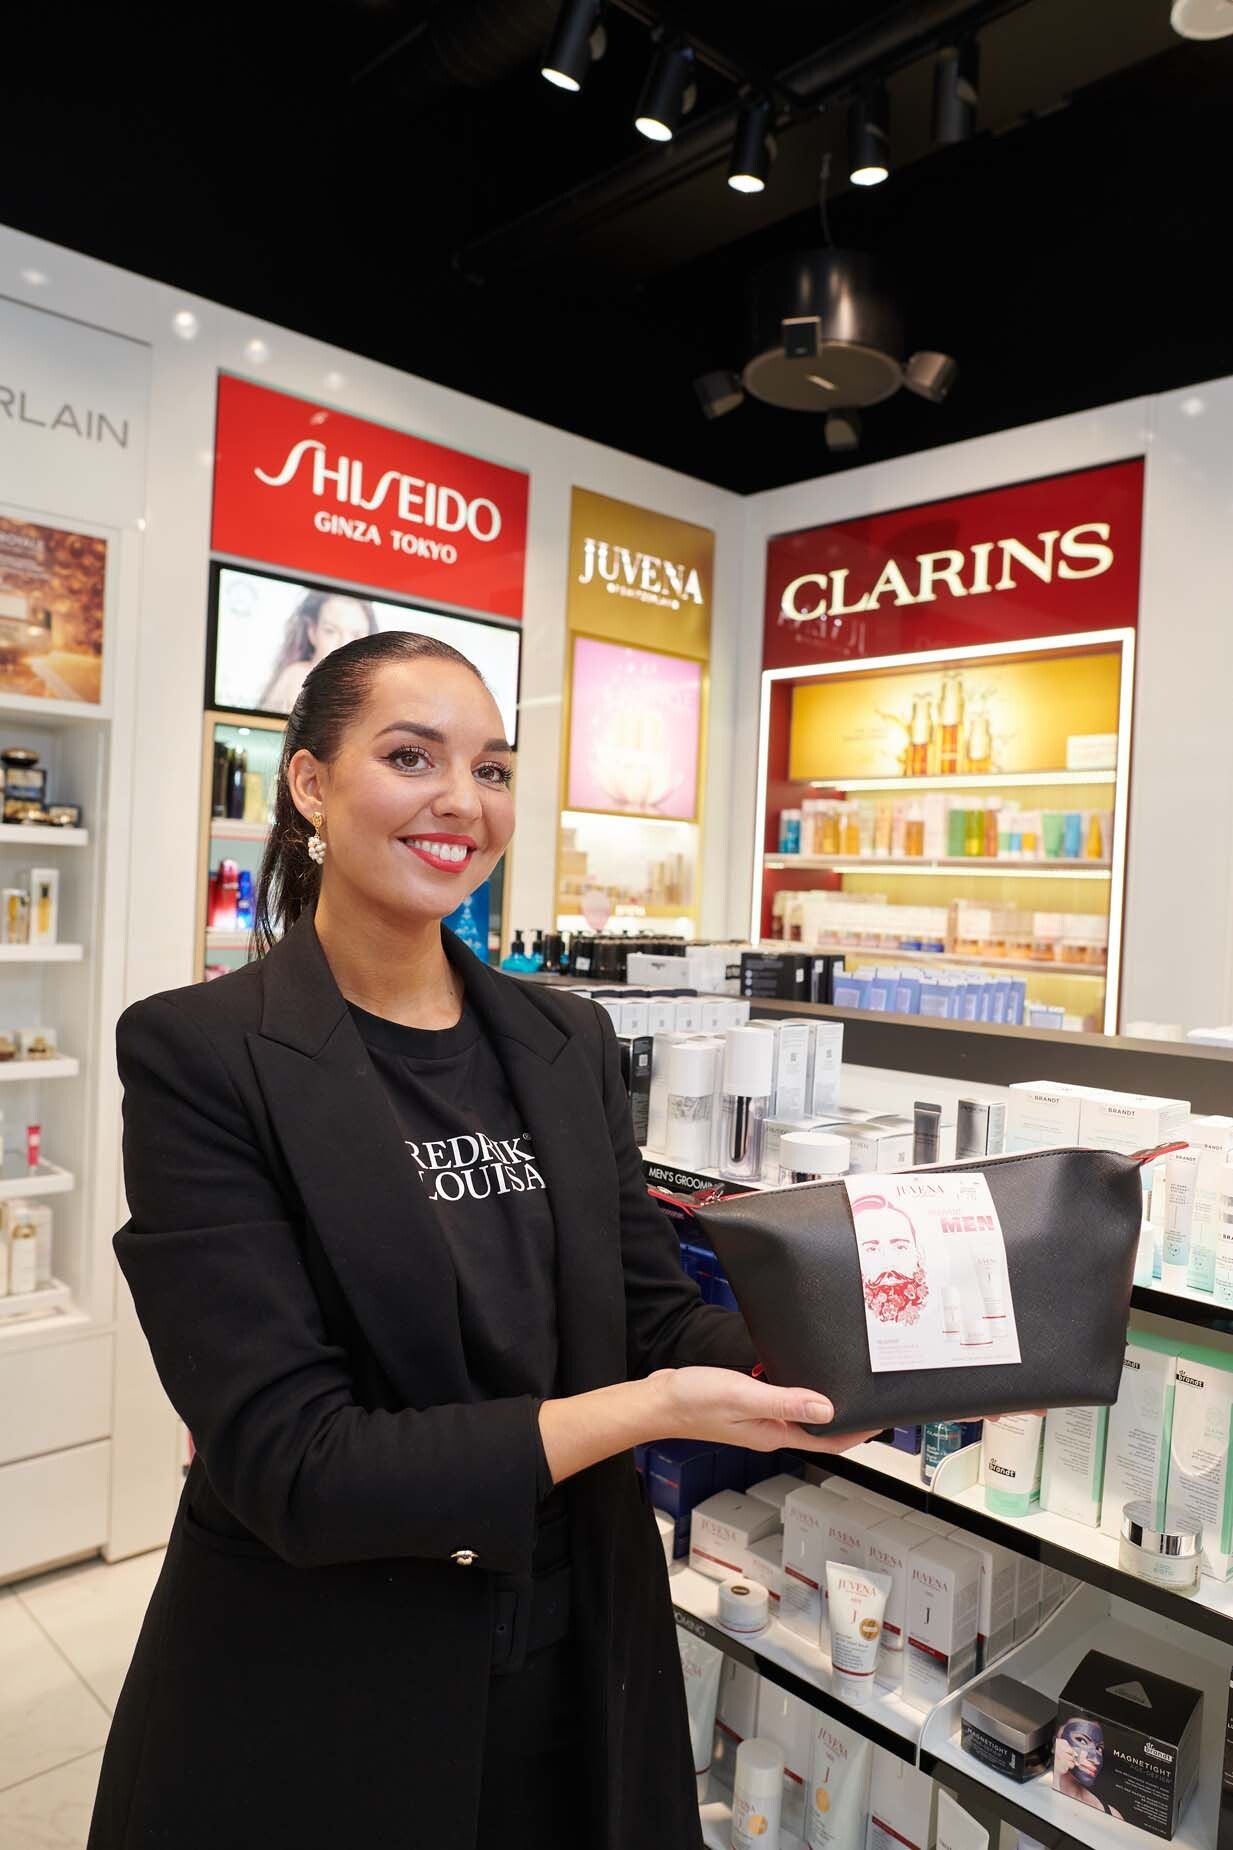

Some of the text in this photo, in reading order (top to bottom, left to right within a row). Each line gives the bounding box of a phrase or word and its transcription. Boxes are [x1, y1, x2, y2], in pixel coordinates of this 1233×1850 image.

[254, 439, 501, 541] SHISEIDO
[314, 511, 458, 564] GINZA TOKYO
[578, 537, 704, 605] JUVENA
[780, 522, 1114, 621] CLARINS
[1034, 1095, 1060, 1104] BRANDT
[1108, 1107, 1135, 1117] BRANDT
[648, 1167, 674, 1183] MEN'S
[941, 1215, 995, 1233] MEN
[1177, 1375, 1204, 1388] brandt
[989, 1463, 1016, 1478] brandt
[870, 1546, 903, 1569] JUVENA
[838, 1578, 877, 1598] JUVENA
[912, 1568, 949, 1593] JUVENA
[817, 1727, 849, 1761] JUVENA
[967, 1727, 1008, 1756] MAGNETIGHT
[1113, 1749, 1171, 1778] MAGNETIGHT
[1144, 1746, 1173, 1763] brandt
